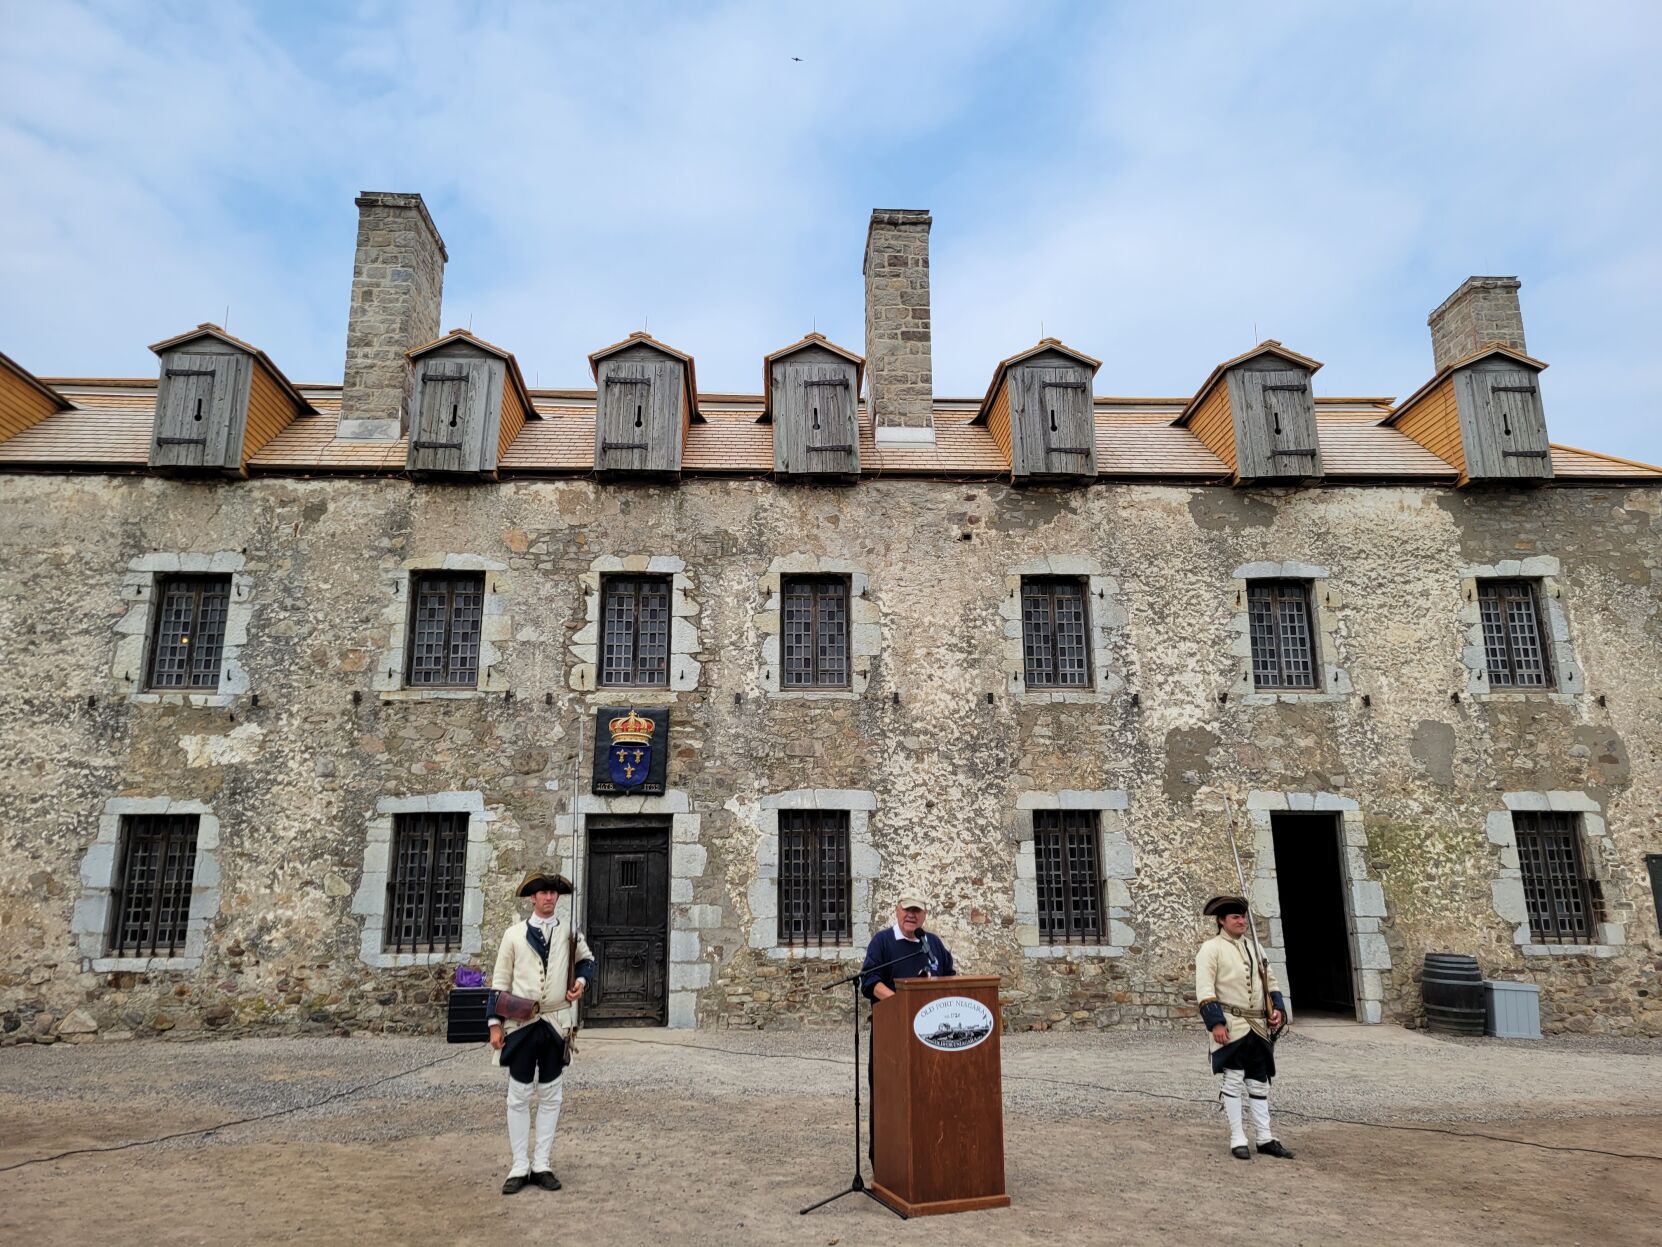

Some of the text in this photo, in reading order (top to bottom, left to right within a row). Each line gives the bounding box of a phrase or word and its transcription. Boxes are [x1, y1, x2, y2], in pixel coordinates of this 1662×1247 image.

[920, 1000, 985, 1018] OLD FORT NIAGARA
